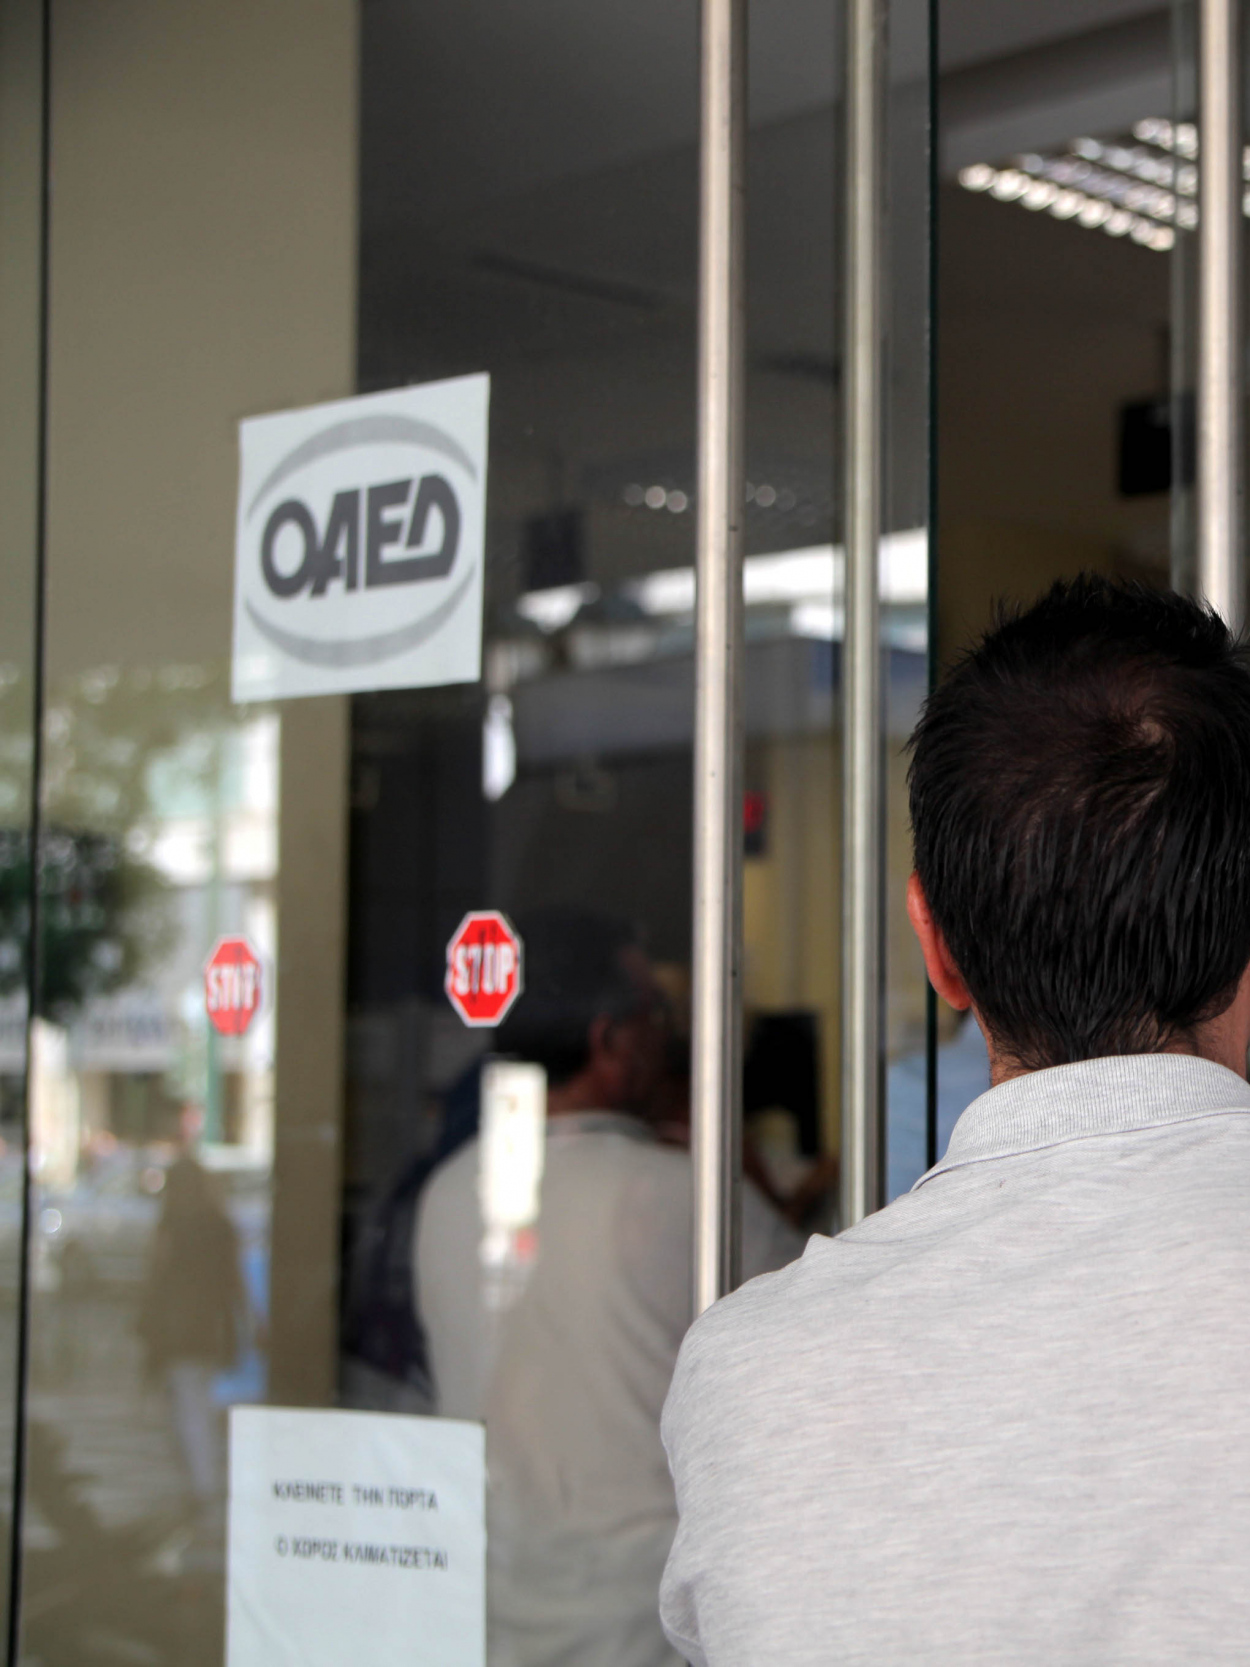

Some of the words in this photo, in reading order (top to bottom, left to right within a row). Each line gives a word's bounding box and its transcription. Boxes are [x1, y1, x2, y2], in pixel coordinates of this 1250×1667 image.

[207, 962, 255, 1011] STOP
[454, 943, 514, 995] STOP
[352, 1484, 384, 1507] ΤΗΝ
